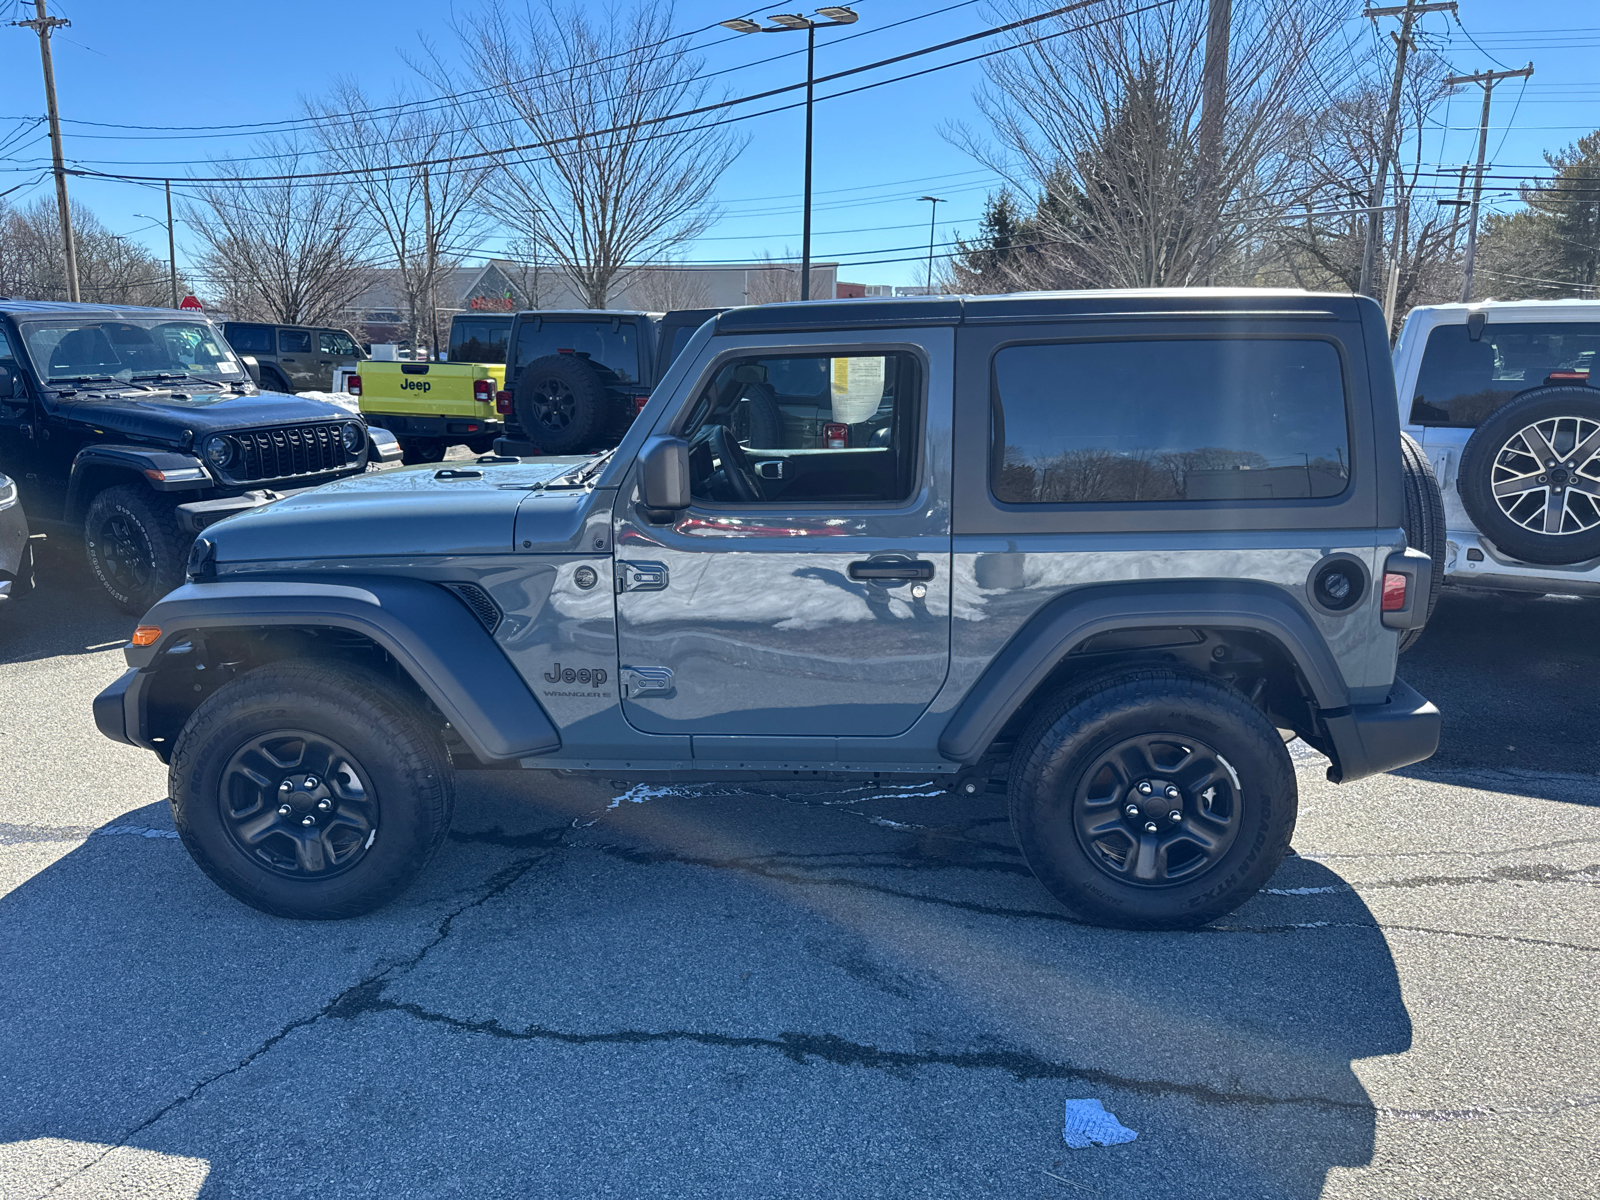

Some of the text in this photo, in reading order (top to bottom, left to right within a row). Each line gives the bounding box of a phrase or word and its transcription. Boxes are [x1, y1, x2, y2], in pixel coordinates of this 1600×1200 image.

[400, 378, 431, 393] Jeep
[544, 663, 607, 688] Jeep
[543, 690, 601, 698] WRANGLER
[1188, 873, 1238, 908] HTX2
